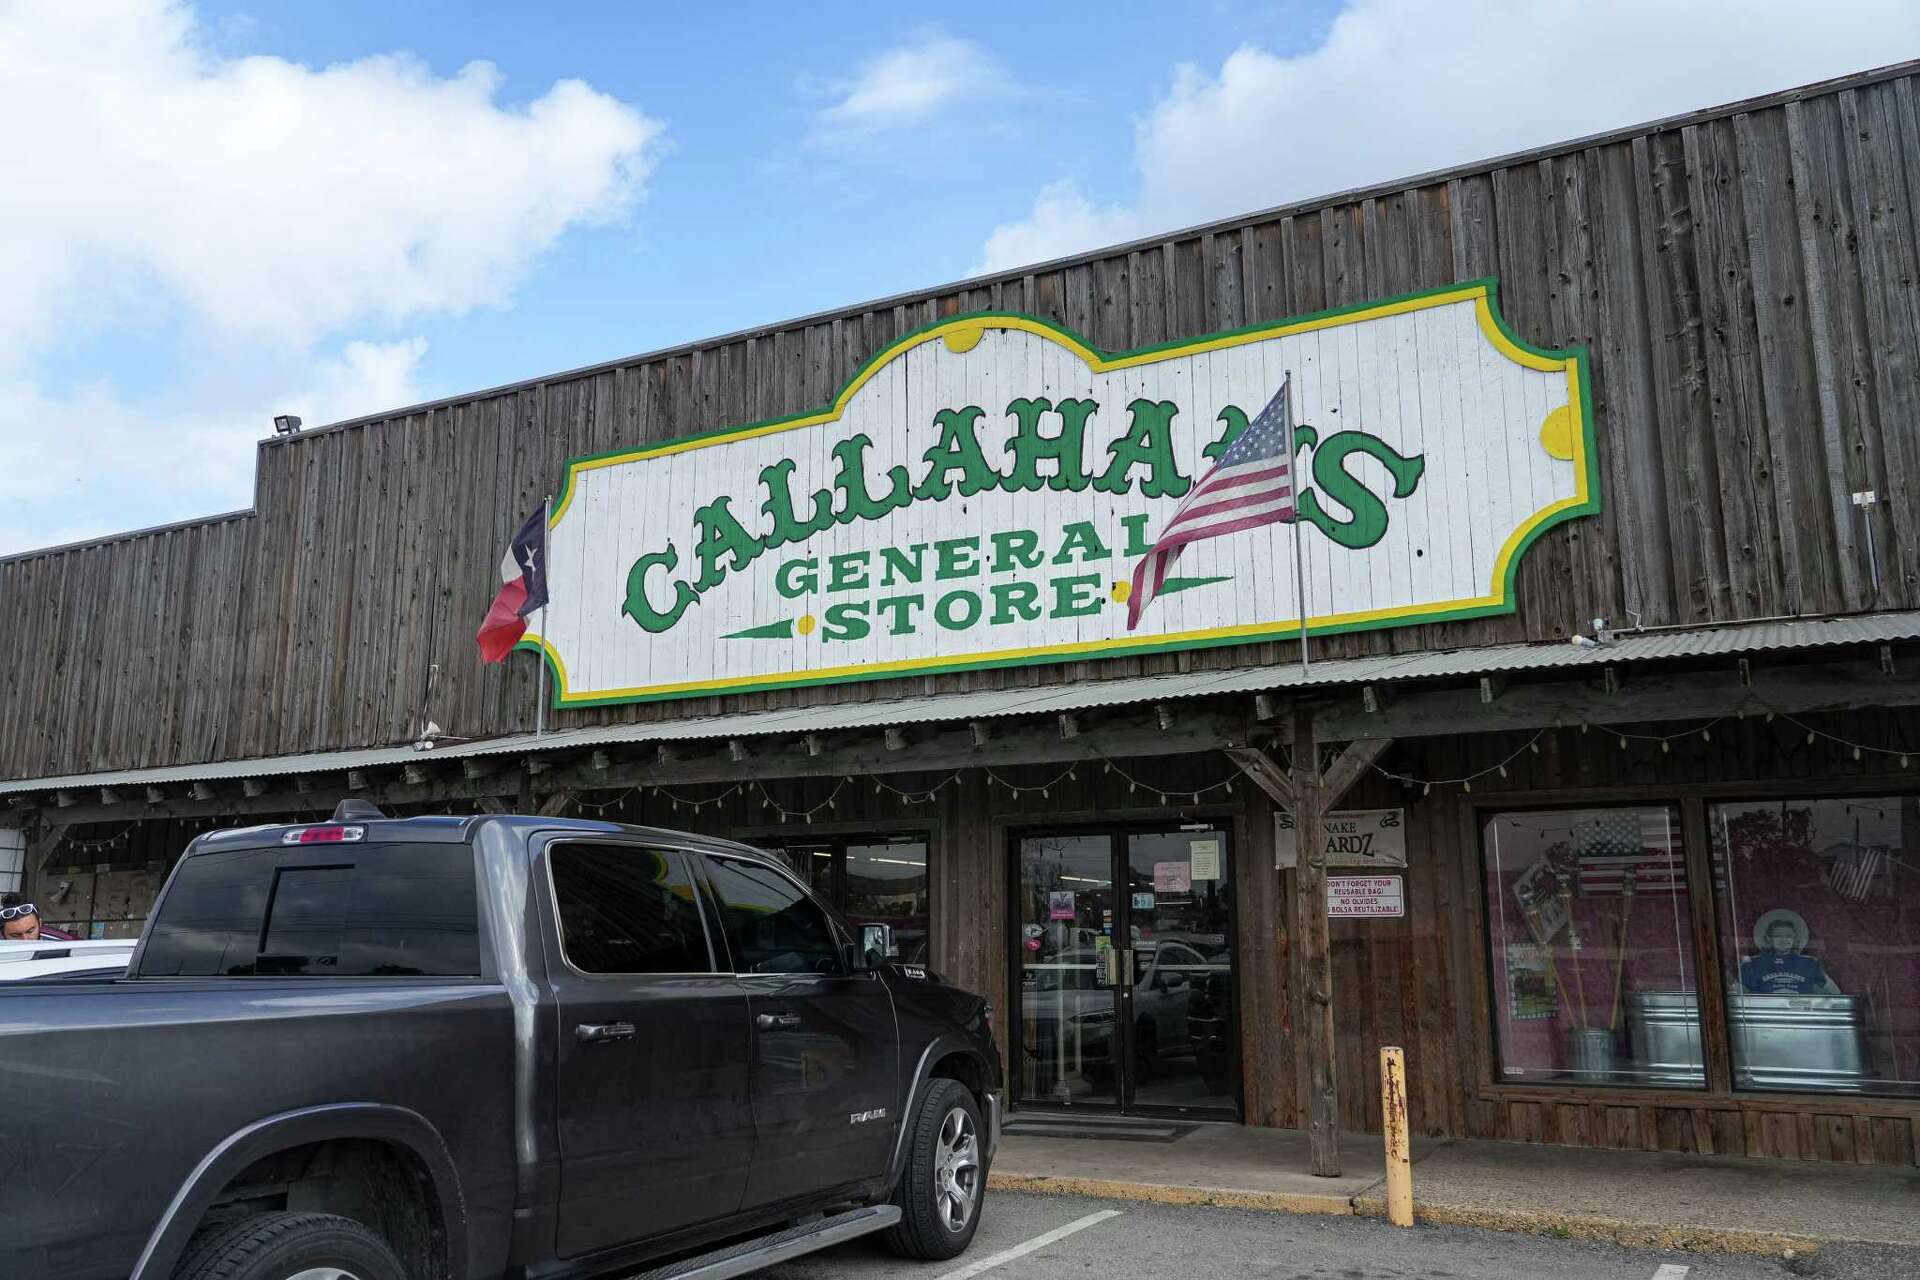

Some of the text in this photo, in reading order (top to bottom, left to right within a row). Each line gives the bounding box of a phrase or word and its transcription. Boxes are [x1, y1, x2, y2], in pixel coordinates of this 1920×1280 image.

[775, 513, 1157, 599] GENERAL
[822, 572, 1103, 643] STORE
[850, 1108, 886, 1124] RAM
